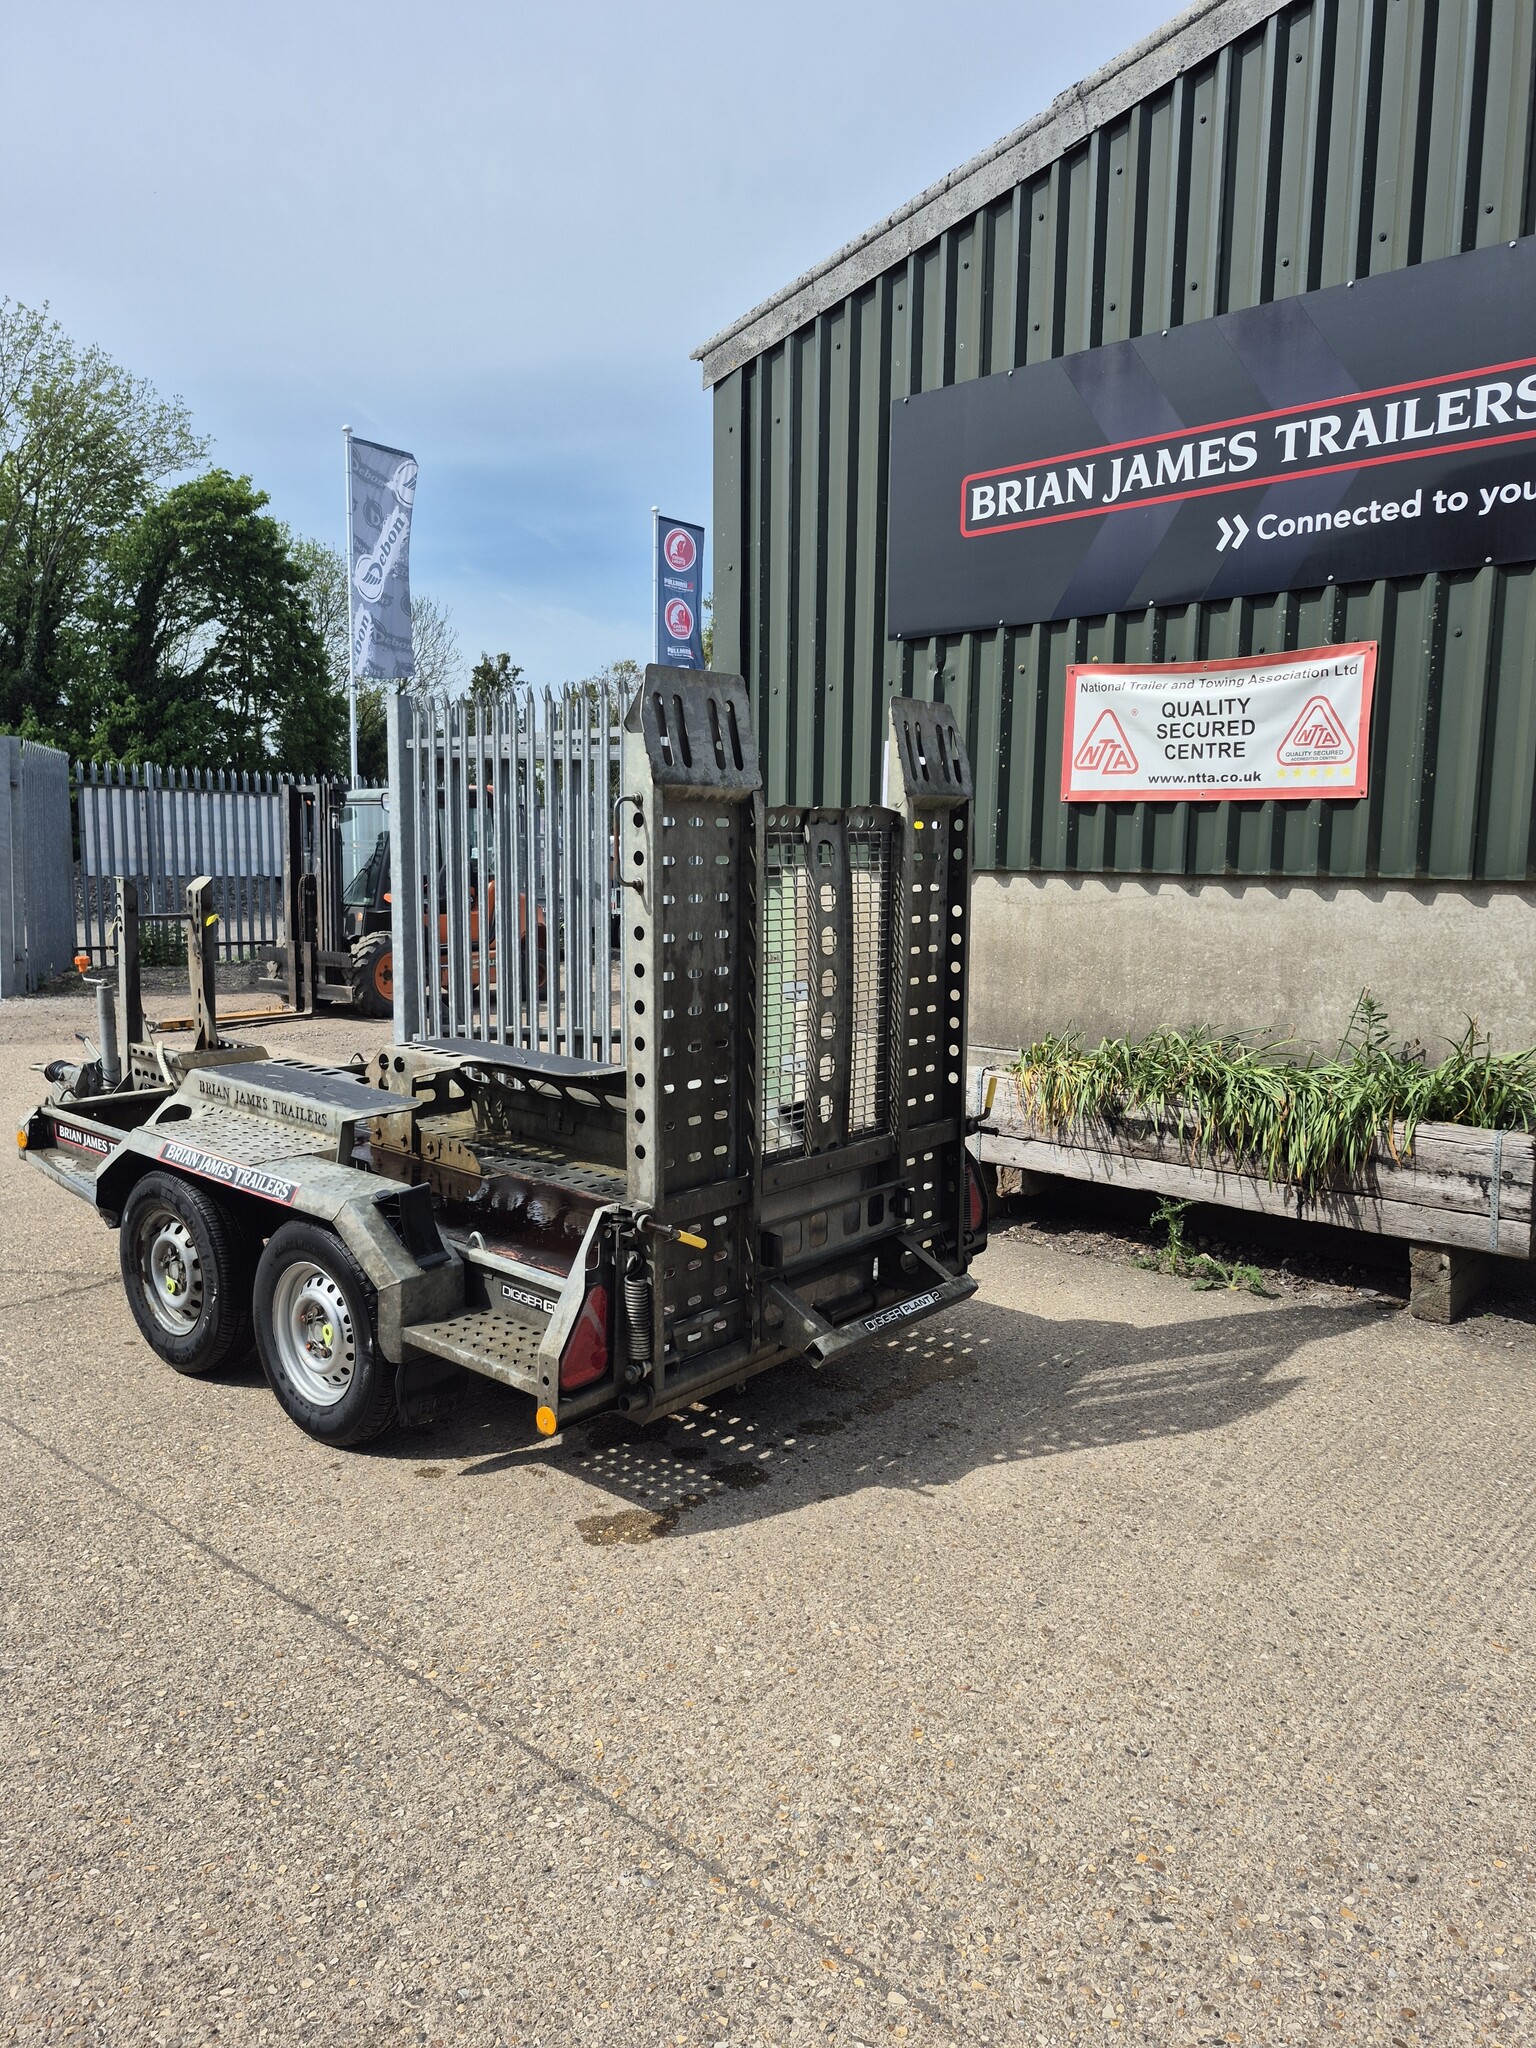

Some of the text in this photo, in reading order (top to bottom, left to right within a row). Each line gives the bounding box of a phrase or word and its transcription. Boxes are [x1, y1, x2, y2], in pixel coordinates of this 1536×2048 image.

[971, 373, 1536, 521] BRIAN JAMES TRAILERS
[1257, 488, 1422, 540] Connected
[1433, 489, 1469, 514] to
[361, 516, 405, 586] Debon
[1080, 663, 1358, 693] National Trailer and Towing Association Ltd
[1161, 697, 1251, 719] QUALITY
[1156, 719, 1256, 740] SECURED
[1298, 725, 1336, 747] NTTA
[1079, 738, 1132, 772] NTTA
[1164, 741, 1246, 760] CENTRE
[1148, 771, 1261, 784] www.ntta.co.uk
[199, 1079, 328, 1127] BRIAN JAMES TRAILERS
[59, 1124, 82, 1143] BRIAN
[82, 1133, 108, 1151] JAMES
[165, 1145, 292, 1201] BRIAN JAMES TRAILERS
[502, 1285, 543, 1310] DIGGER
[864, 1291, 942, 1331] DIGGER PLANT 2
